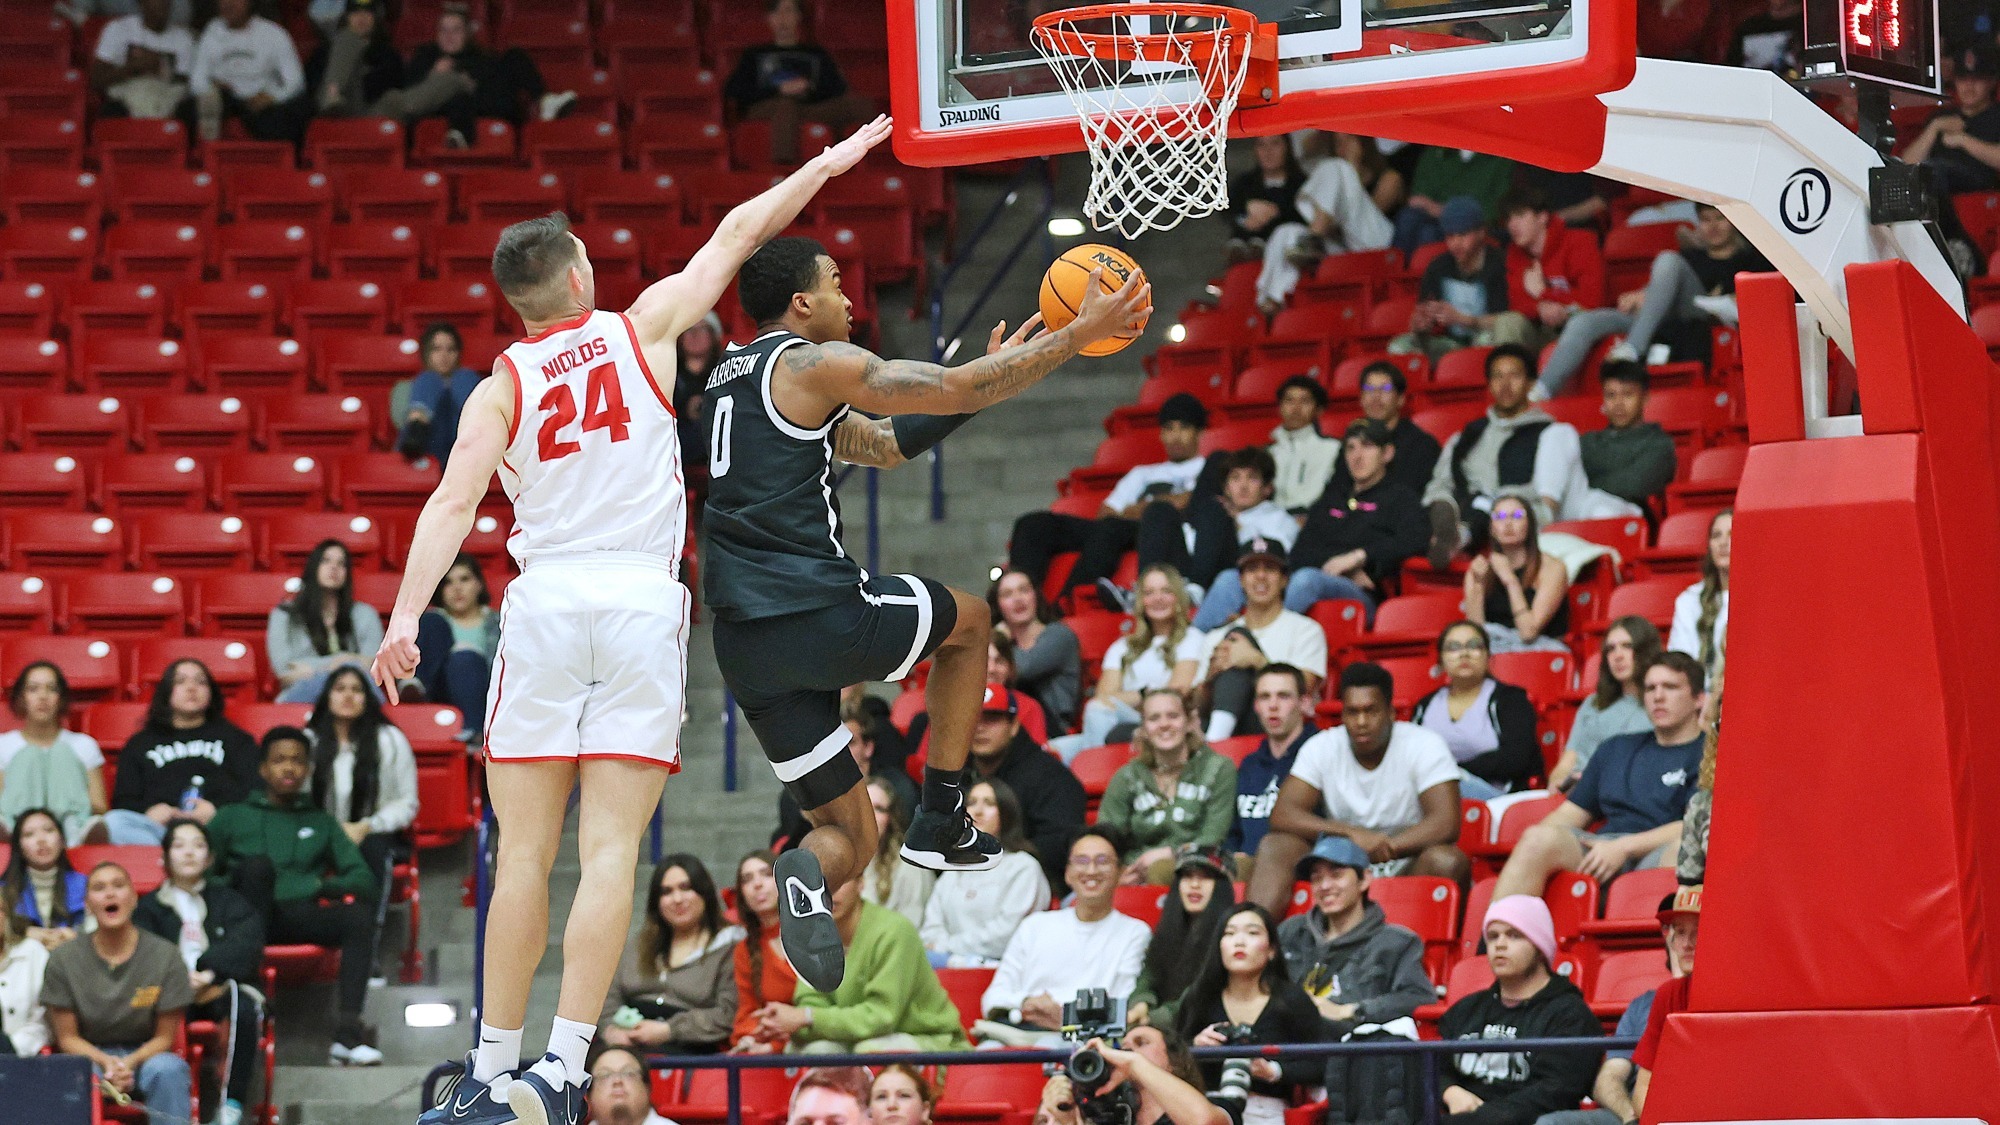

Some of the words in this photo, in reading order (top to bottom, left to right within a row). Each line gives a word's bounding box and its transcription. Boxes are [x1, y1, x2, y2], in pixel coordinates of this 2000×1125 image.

[939, 104, 1000, 127] SPALDING
[1091, 252, 1131, 282] NCA
[537, 361, 631, 462] 24
[709, 394, 735, 479] 0
